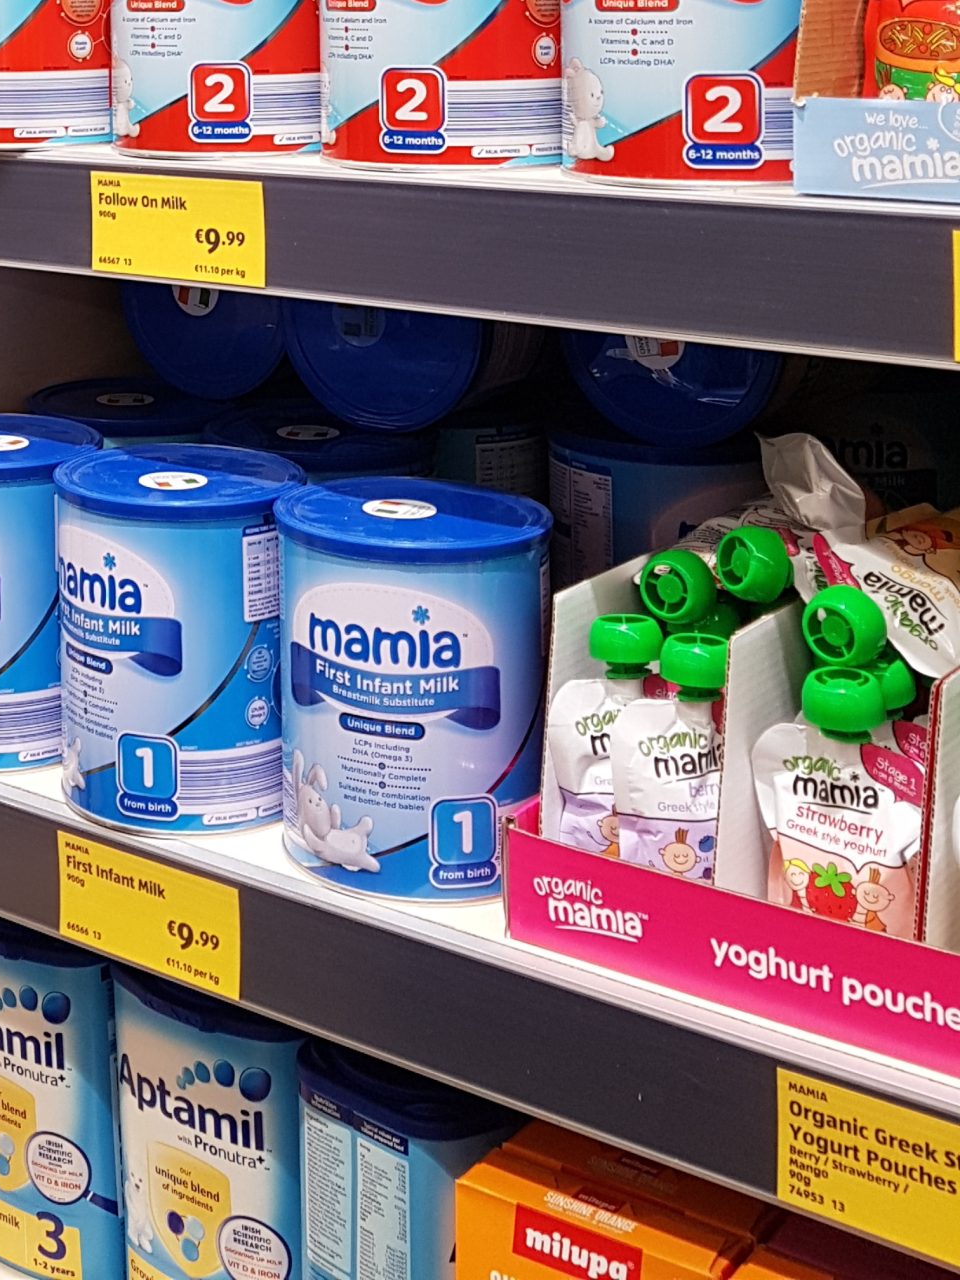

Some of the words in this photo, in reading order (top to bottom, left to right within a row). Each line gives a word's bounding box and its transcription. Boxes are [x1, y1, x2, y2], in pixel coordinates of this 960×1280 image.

[204, 74, 235, 112] 2
[395, 79, 428, 120] 2
[704, 86, 743, 132] 2
[384, 136, 403, 144] 6-12
[406, 136, 443, 145] months
[834, 125, 915, 157] organic
[851, 137, 960, 182] mamia
[99, 193, 137, 207] Follow
[142, 196, 157, 208] On
[161, 196, 187, 210] Milk
[99, 210, 116, 220] 900g
[309, 605, 461, 670] mamia
[316, 660, 350, 686] First
[357, 675, 412, 695] Infant
[420, 677, 459, 694] Milk
[136, 748, 152, 788] 1
[389, 772, 426, 784] Complete
[124, 798, 145, 811] from
[148, 801, 171, 813] birth
[793, 772, 879, 809] mamia
[453, 810, 474, 853] 1
[787, 819, 818, 839] Greek
[822, 832, 840, 847] style
[843, 838, 886, 858] yoghurt
[796, 804, 883, 844] strawberry
[65, 841, 89, 855] MAMIA
[66, 855, 92, 875] First
[97, 865, 135, 889] Infant
[138, 879, 165, 899] Milk
[534, 876, 602, 905] organic
[548, 898, 642, 938] mamia
[710, 938, 833, 992] yoghurt
[120, 1053, 264, 1151] Aptamil
[789, 1082, 828, 1102] MAMIA
[789, 1101, 869, 1140] Organic
[875, 1128, 938, 1163] Greek
[789, 1123, 859, 1162] Yogurt
[867, 1150, 957, 1195] Pouches
[790, 1158, 828, 1179] Mango
[155, 1166, 188, 1189] unique
[190, 1181, 219, 1202] blend
[0, 1210, 19, 1229] milk
[544, 1191, 594, 1217] SUNSHINE
[37, 1211, 65, 1260] 3
[525, 1227, 628, 1280] milupa
